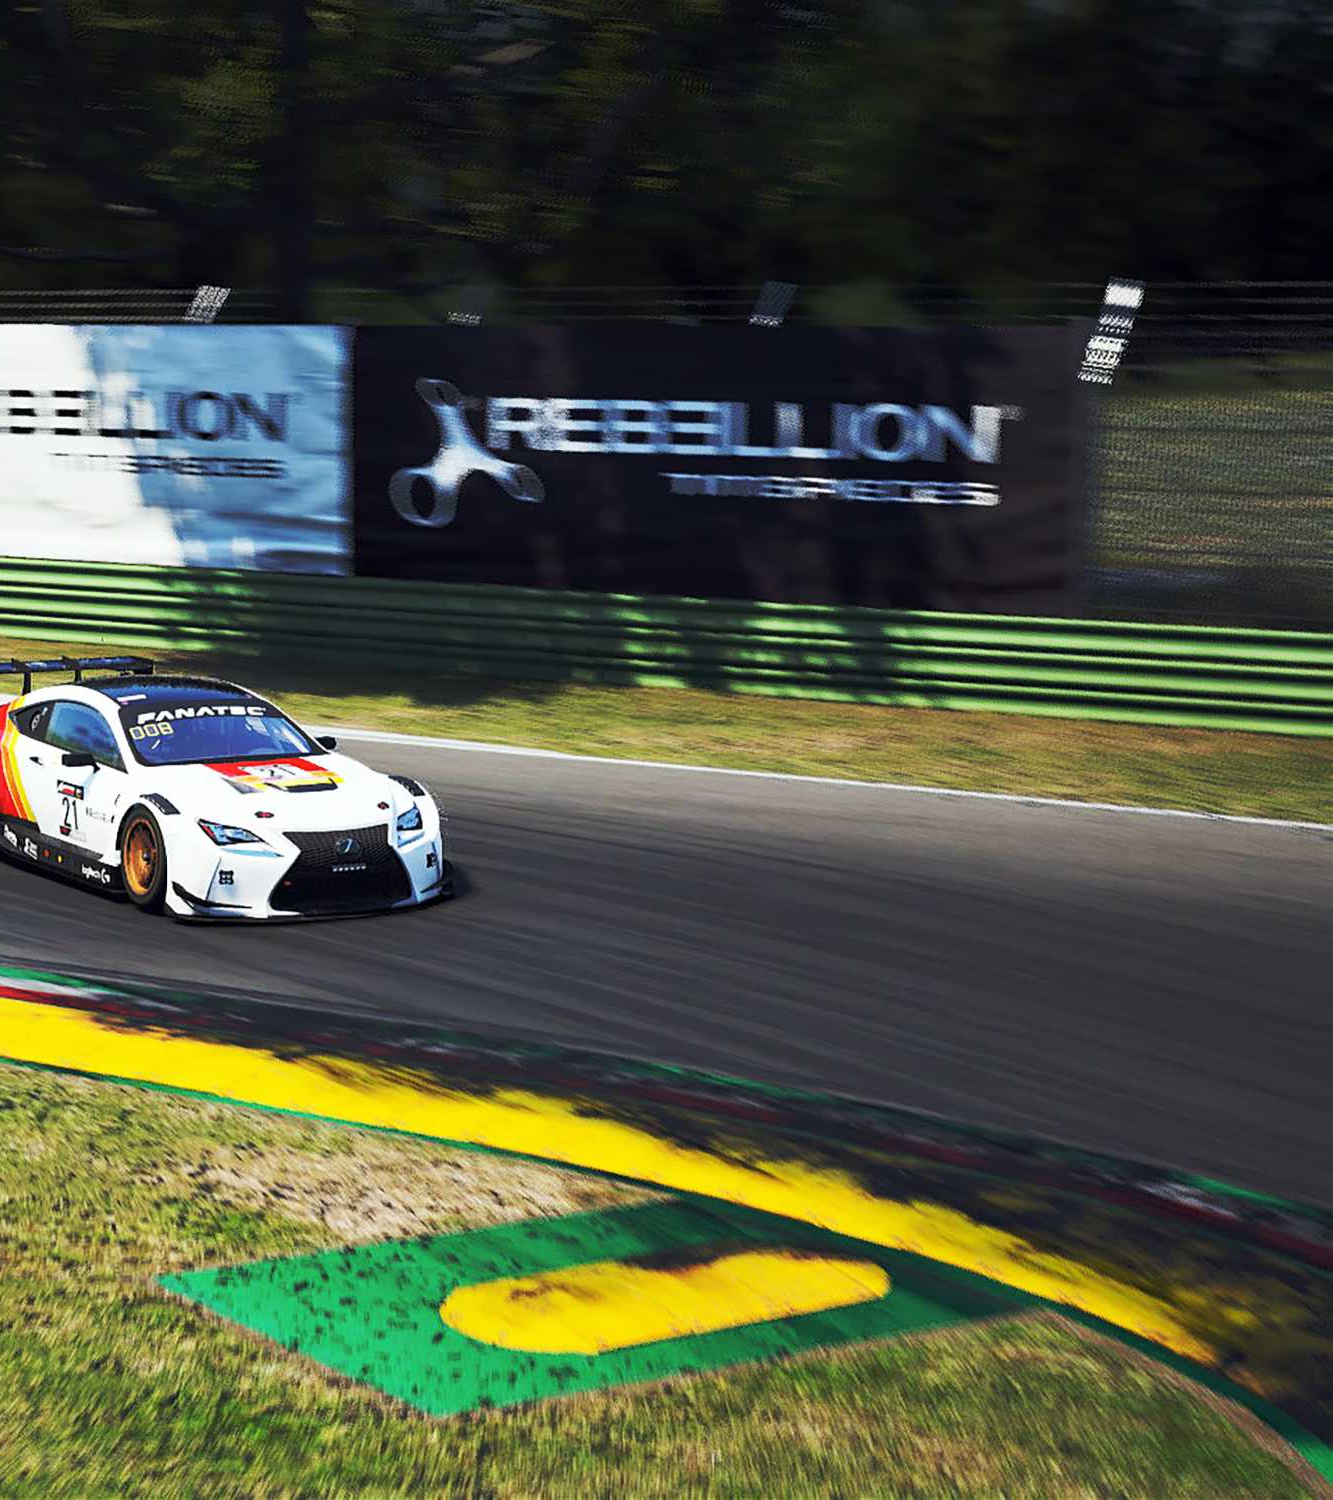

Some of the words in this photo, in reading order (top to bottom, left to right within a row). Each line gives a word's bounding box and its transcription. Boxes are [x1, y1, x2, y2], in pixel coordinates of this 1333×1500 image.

[485, 396, 1004, 464] REBELLION
[137, 705, 267, 725] FANATEC
[62, 796, 79, 831] 21
